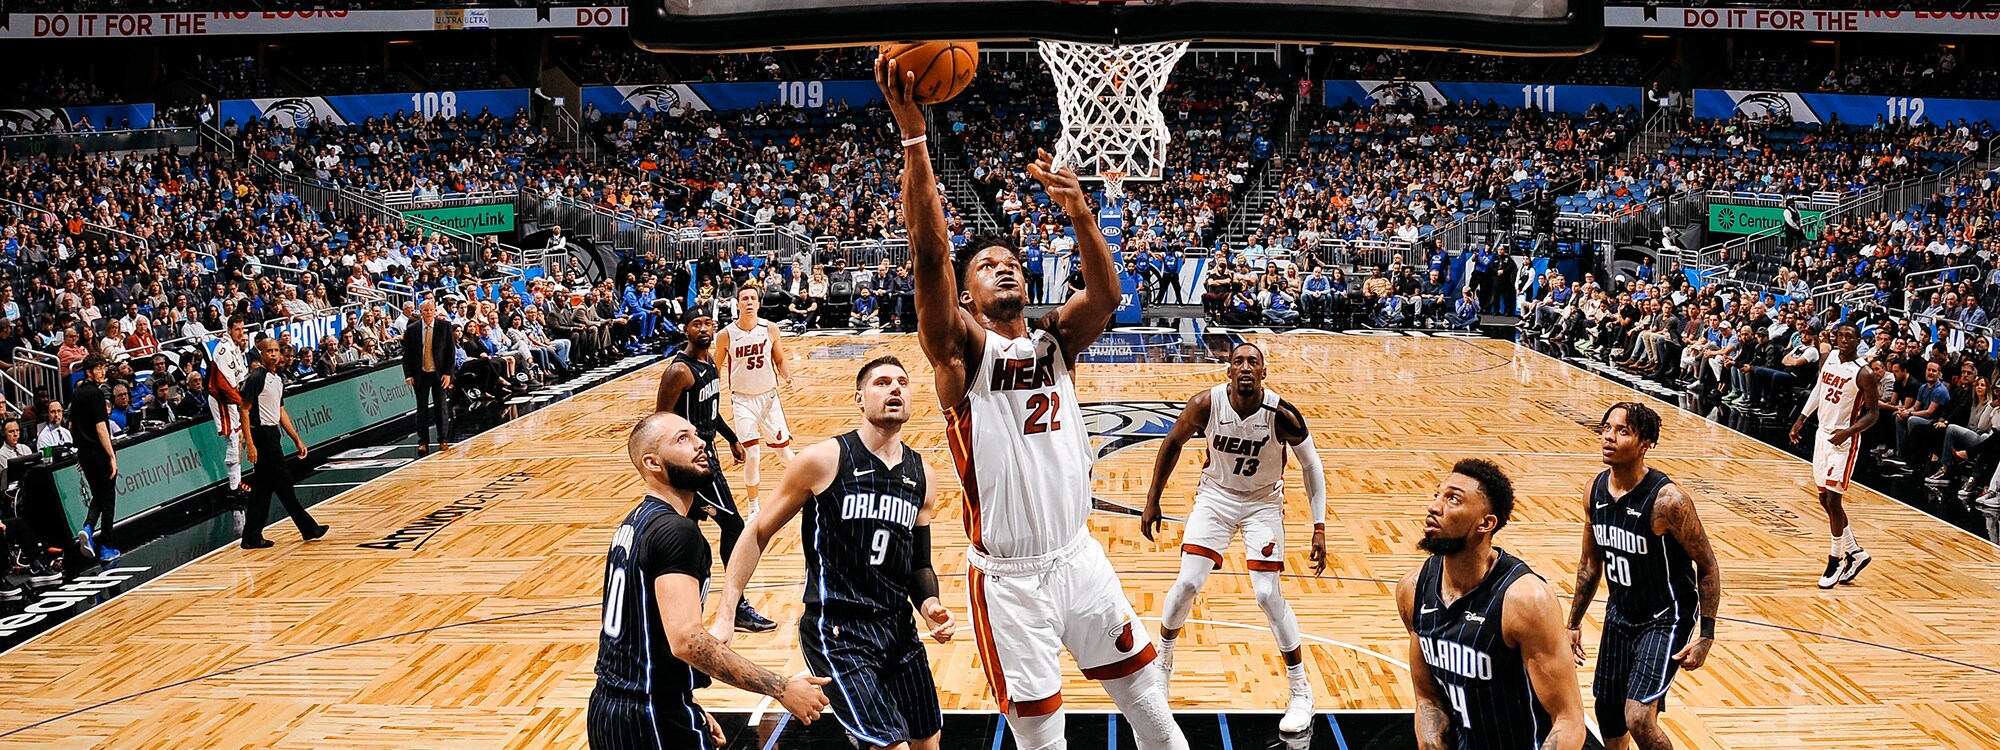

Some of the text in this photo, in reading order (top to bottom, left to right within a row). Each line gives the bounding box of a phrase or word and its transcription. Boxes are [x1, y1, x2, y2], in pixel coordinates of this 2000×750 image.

[34, 15, 69, 37] DO
[78, 15, 97, 37] IT
[105, 14, 152, 36] FOR
[161, 14, 207, 34] THE
[436, 16, 462, 24] ULTRA
[465, 16, 488, 24] ULTRA
[577, 8, 628, 26] DO I
[1683, 9, 1719, 28] DO
[1727, 10, 1747, 28] IT
[1756, 10, 1804, 30] FOR
[1812, 11, 1858, 30] THE
[412, 91, 456, 122] 108
[778, 80, 823, 108] 109
[1522, 85, 1555, 113] 111
[1886, 97, 1925, 127] 112
[431, 212, 505, 230] CenturyLink
[735, 339, 767, 358] HEAT
[746, 355, 764, 370] 55
[380, 382, 414, 403] Century
[1822, 371, 1852, 389] HEAT
[1825, 387, 1842, 404] 25
[1023, 392, 1061, 435] 22
[1213, 434, 1270, 457] HEAT
[115, 448, 201, 496] CenturyLink
[1233, 457, 1260, 477] 13
[841, 492, 918, 531] ORLANDO
[869, 528, 890, 566] 9
[1593, 524, 1648, 555] RLANDO
[1606, 550, 1631, 587] 20
[604, 563, 626, 638] 0
[1419, 636, 1492, 680] RLANDO
[1434, 675, 1471, 729] 4
